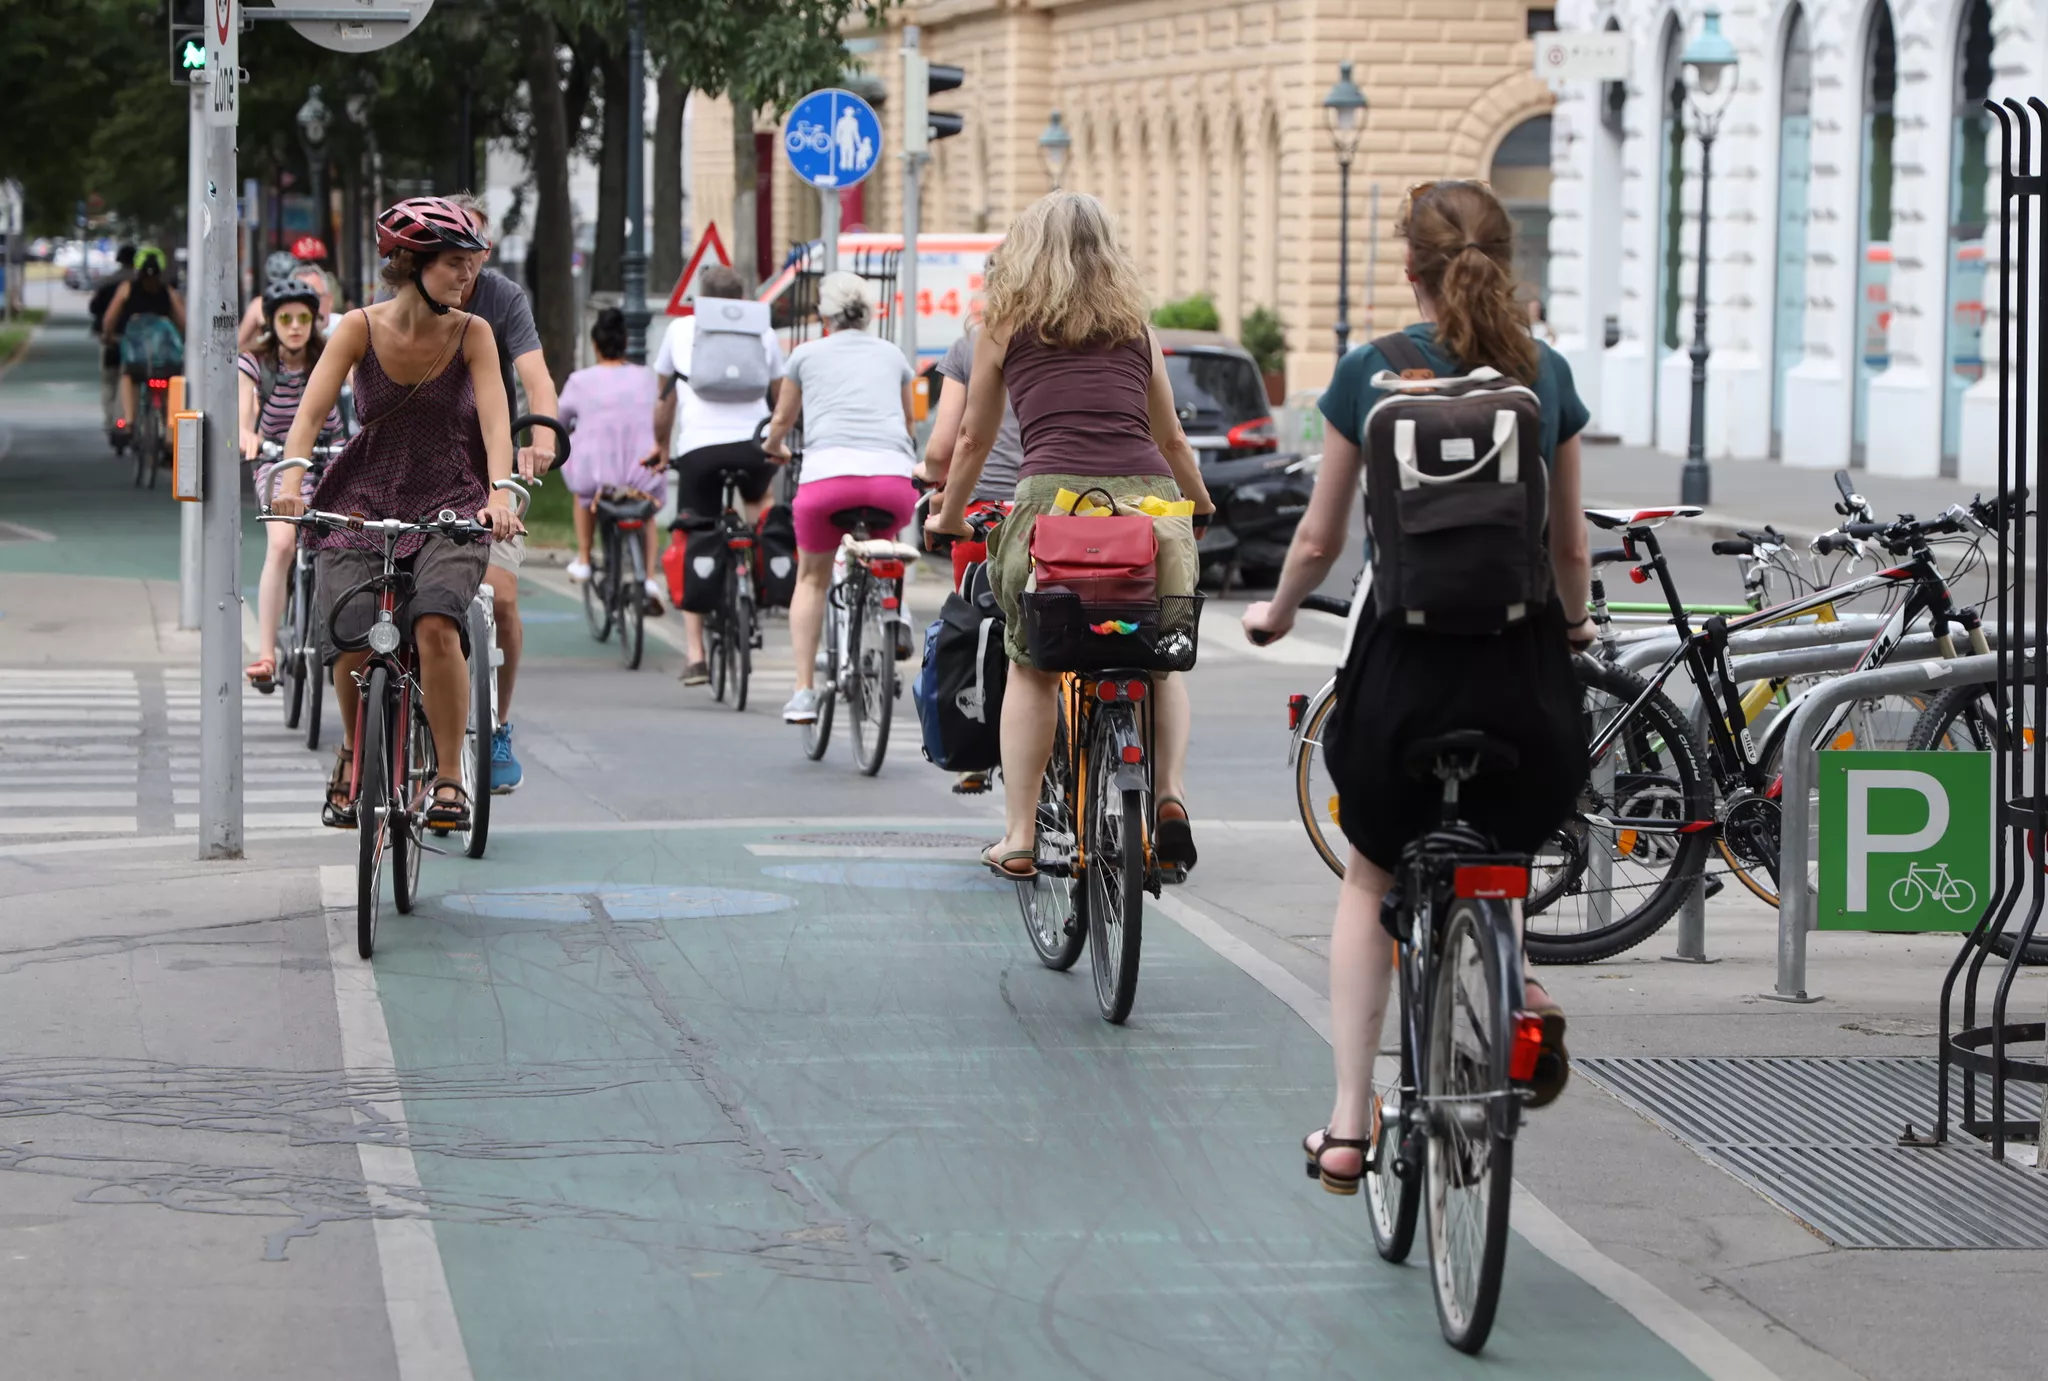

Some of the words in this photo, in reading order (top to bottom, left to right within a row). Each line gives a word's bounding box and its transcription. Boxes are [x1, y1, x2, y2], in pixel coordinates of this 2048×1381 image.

[214, 51, 234, 113] Zone
[1678, 733, 1701, 781] RAPID
[1743, 731, 1757, 760] ABUS
[1846, 769, 1950, 912] P
